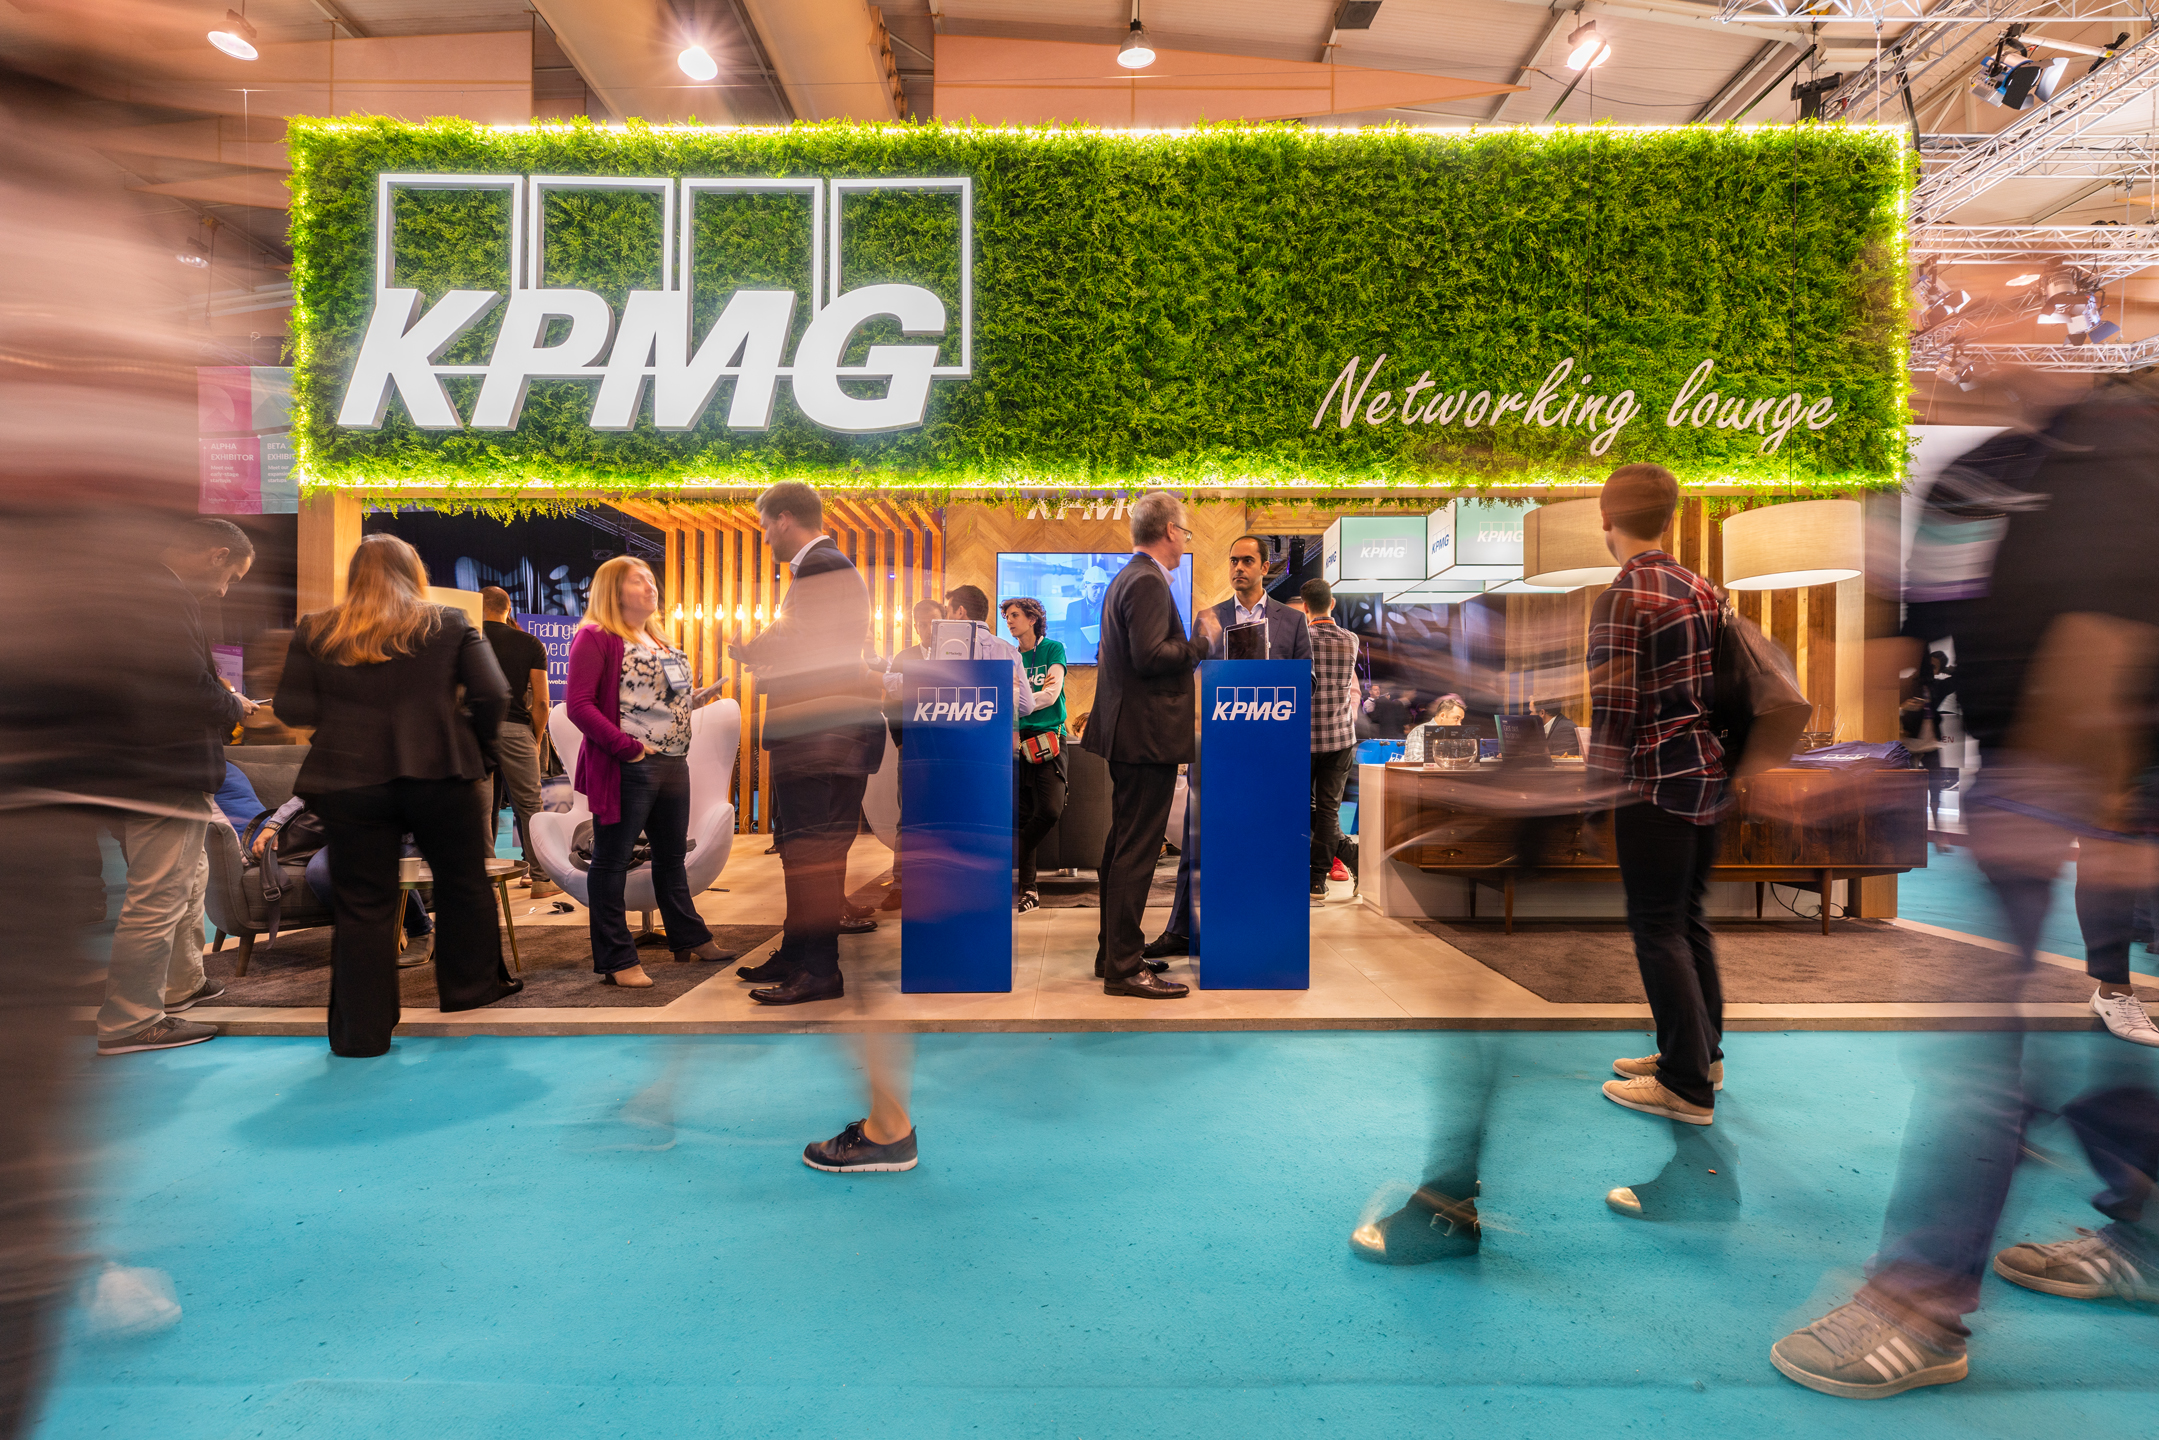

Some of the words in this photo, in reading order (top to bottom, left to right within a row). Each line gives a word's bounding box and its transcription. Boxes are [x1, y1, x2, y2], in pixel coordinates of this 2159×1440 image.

[337, 284, 946, 432] KPMG
[1312, 353, 1642, 457] Networking
[1667, 358, 1838, 456] lounge
[210, 453, 254, 461] EXHIBITOR
[1431, 534, 1450, 555] KPMG
[1477, 530, 1523, 542] KPMG
[1360, 546, 1406, 559] KPMG
[528, 620, 570, 640] Enabling
[913, 701, 995, 721] KPMG
[1212, 700, 1293, 721] KPMG
